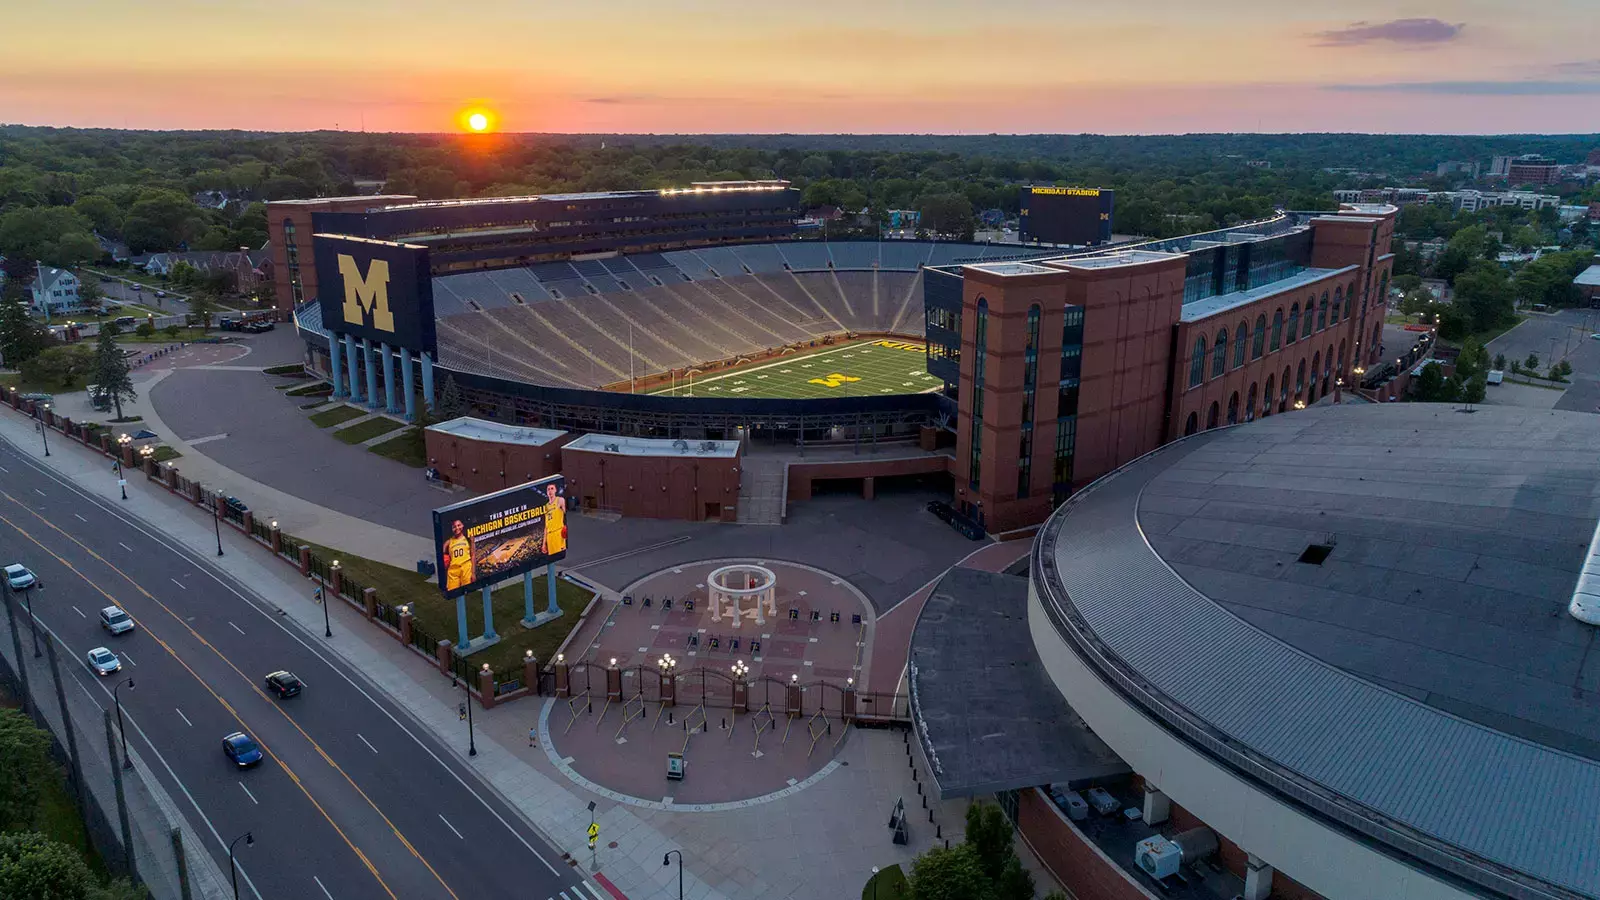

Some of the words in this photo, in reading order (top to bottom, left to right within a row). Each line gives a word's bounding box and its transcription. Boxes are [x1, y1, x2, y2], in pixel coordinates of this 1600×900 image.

[1031, 187, 1066, 195] MICHIGAN
[1067, 189, 1099, 197] STADIUM
[337, 253, 395, 333] M
[490, 511, 503, 521] THIS
[504, 506, 520, 516] WEEK
[467, 518, 503, 538] MICHIGAN
[504, 505, 547, 527] BASKETBALL
[454, 548, 464, 558] 00
